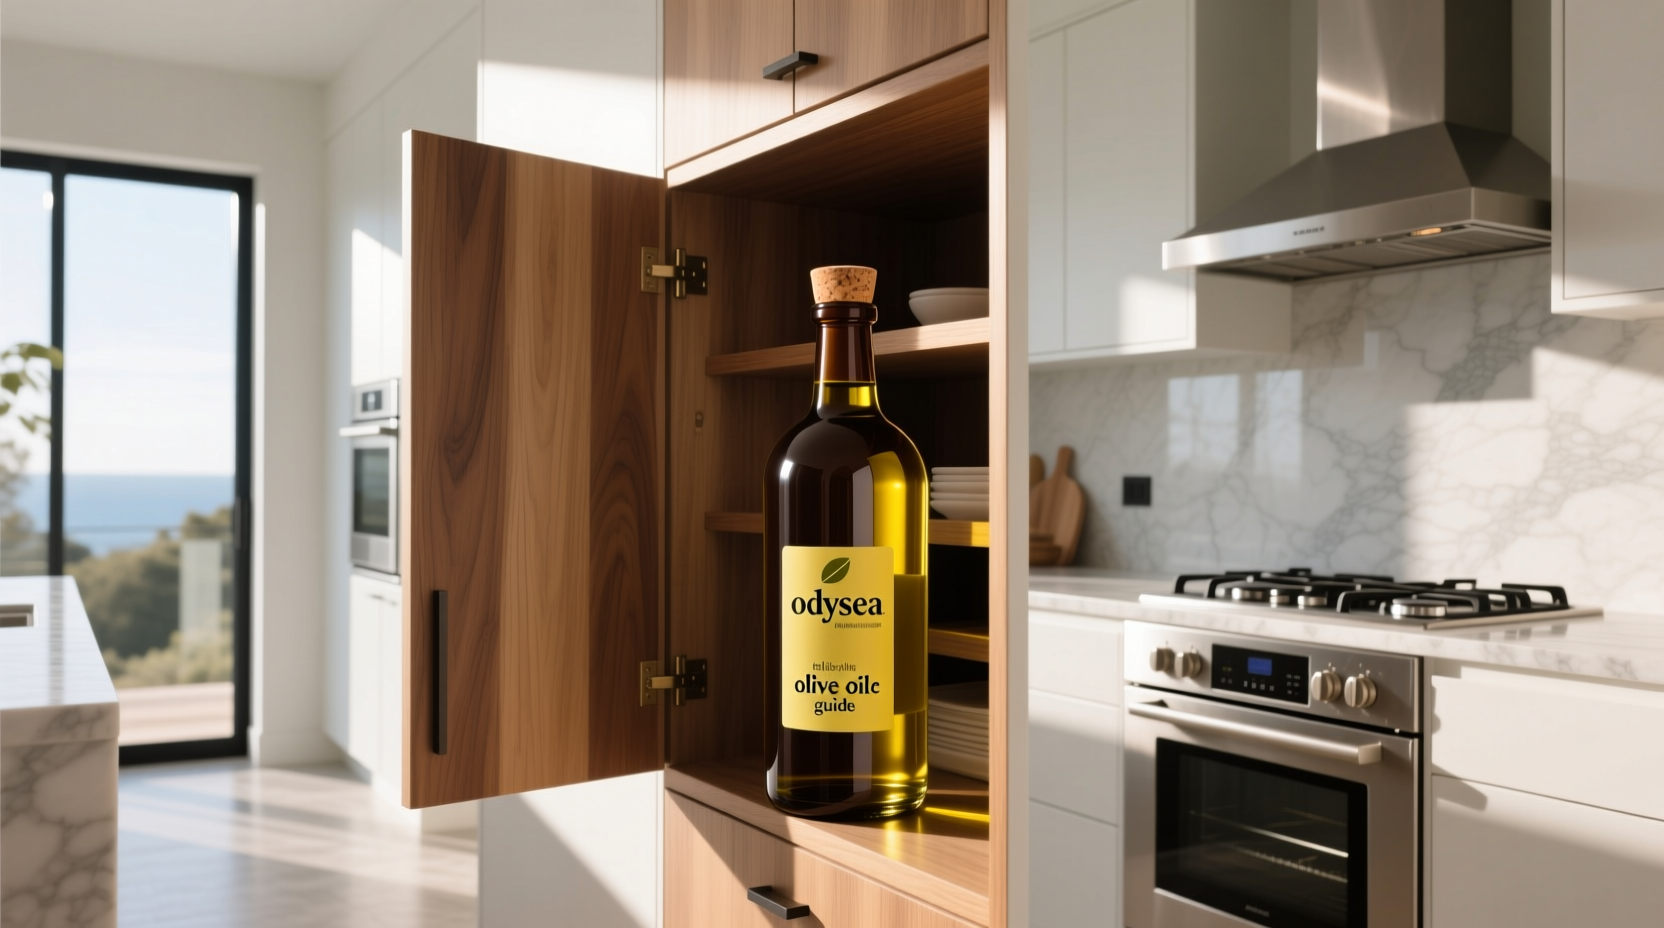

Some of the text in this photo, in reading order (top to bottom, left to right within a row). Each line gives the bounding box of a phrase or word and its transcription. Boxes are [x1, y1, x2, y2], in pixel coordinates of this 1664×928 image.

[791, 588, 884, 624] odysea
[794, 674, 839, 695] olive
[814, 697, 856, 716] guide
